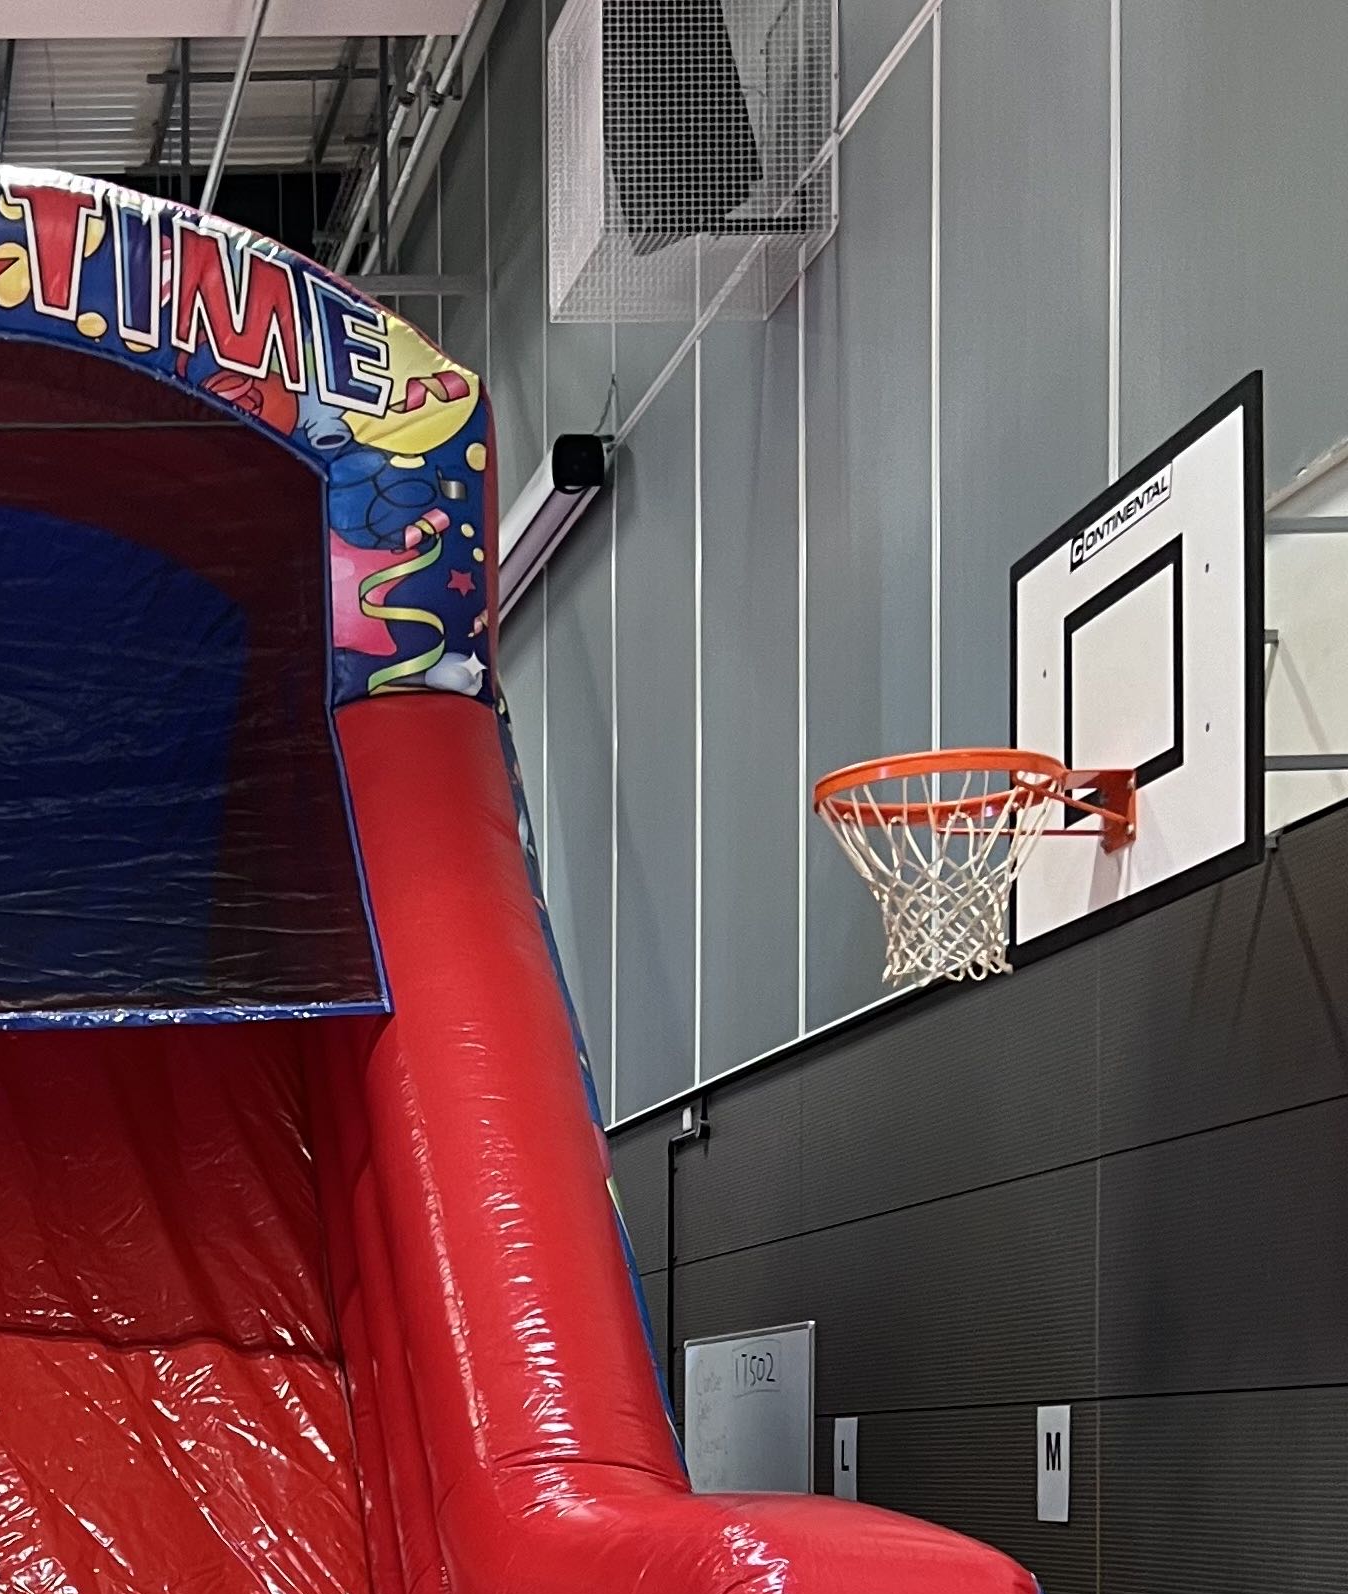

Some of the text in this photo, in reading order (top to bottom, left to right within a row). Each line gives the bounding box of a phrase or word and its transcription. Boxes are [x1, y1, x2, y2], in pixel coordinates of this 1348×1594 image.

[4, 182, 393, 419] TIME
[1071, 475, 1169, 565] CONTINENTAL
[841, 1439, 850, 1472] L
[1045, 1431, 1061, 1471] M
